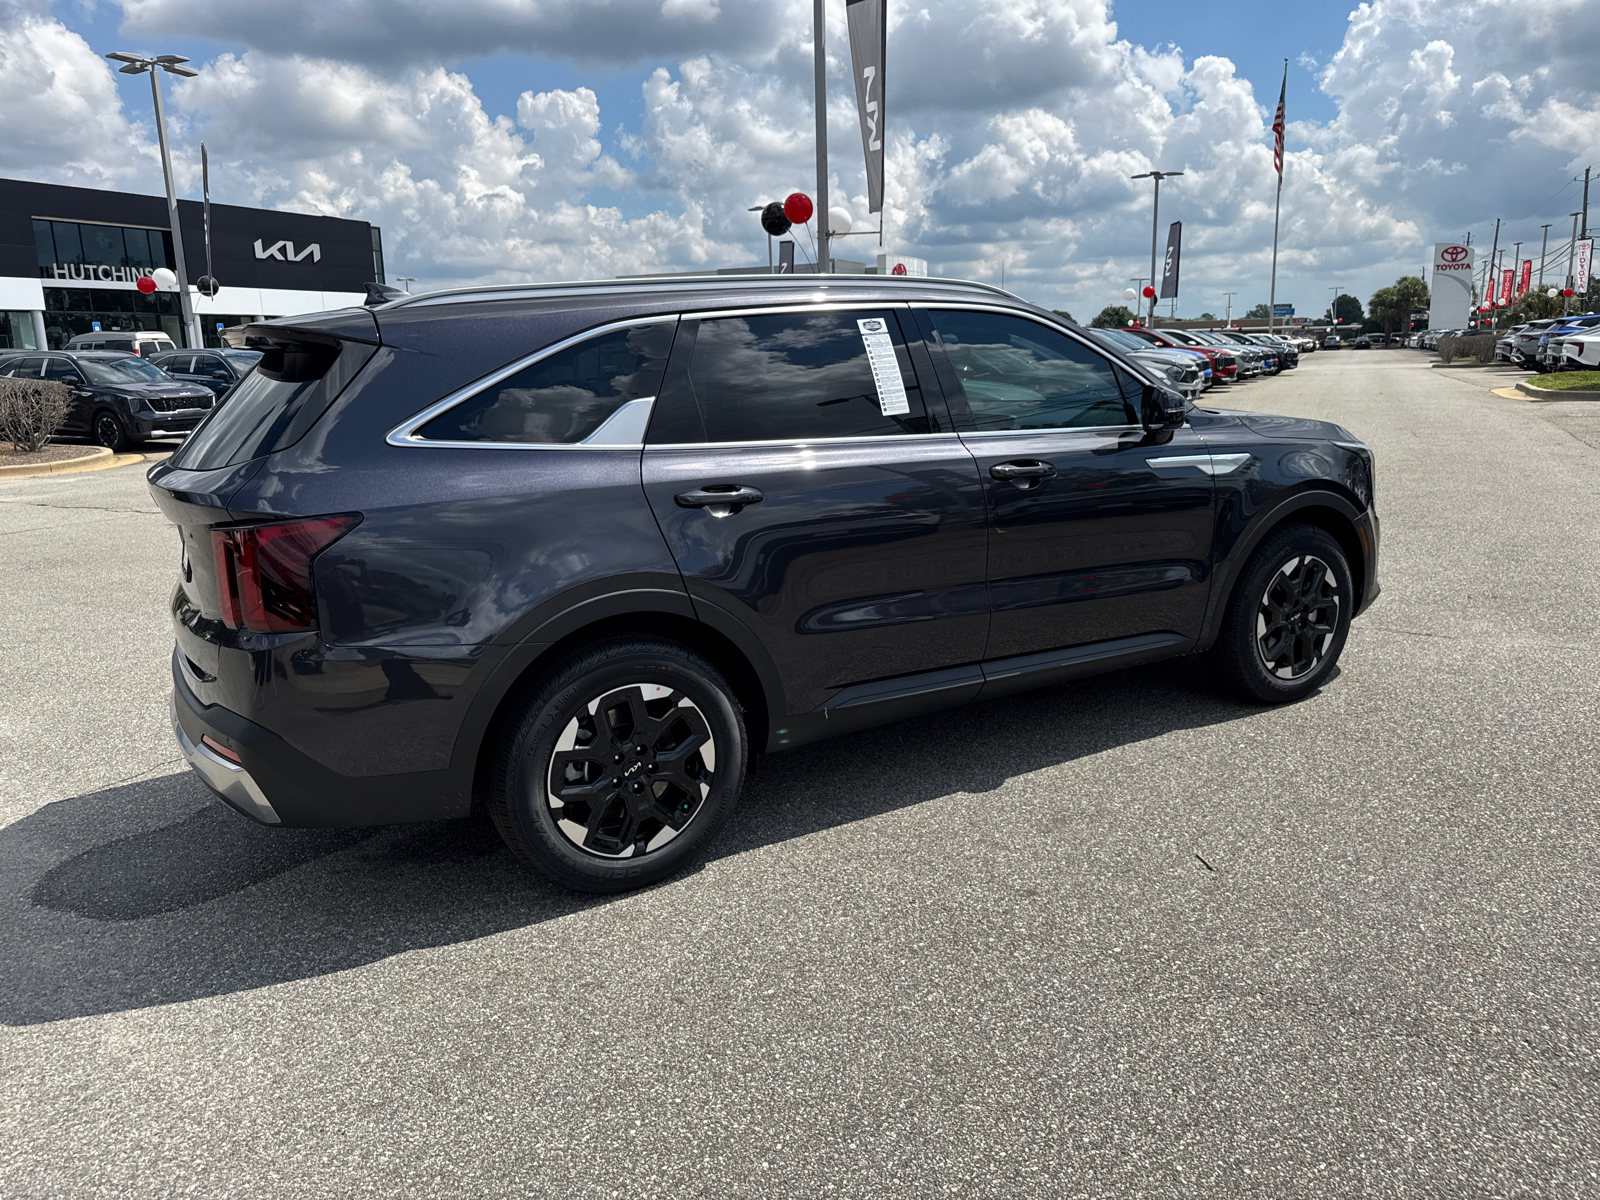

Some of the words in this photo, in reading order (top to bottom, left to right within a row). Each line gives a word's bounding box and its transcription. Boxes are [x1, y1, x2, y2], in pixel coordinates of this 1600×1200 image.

[253, 238, 321, 263] KIA
[52, 262, 179, 285] HUTCHINS
[1435, 262, 1472, 271] TOYOTA
[1578, 250, 1586, 289] TOYOTA
[555, 685, 579, 709] SPORT
[624, 761, 642, 777] KIA
[531, 809, 642, 879] CONTINENTAL
